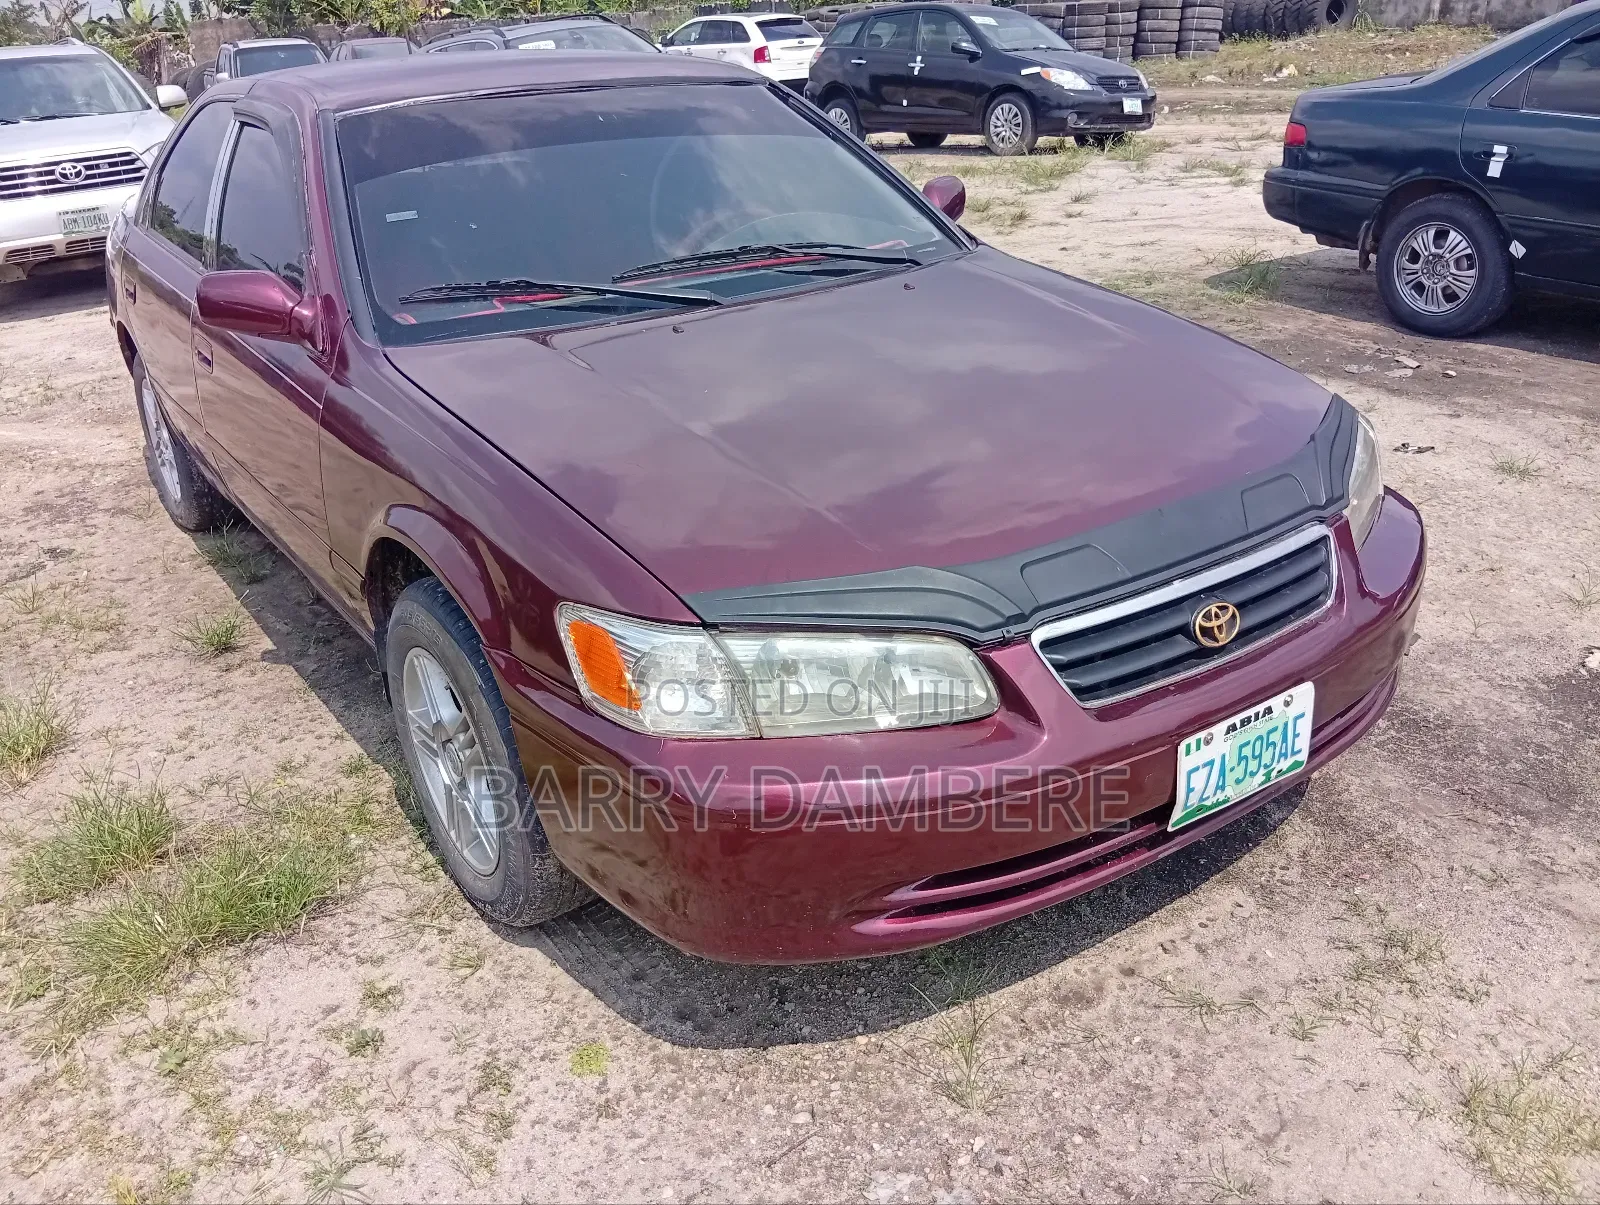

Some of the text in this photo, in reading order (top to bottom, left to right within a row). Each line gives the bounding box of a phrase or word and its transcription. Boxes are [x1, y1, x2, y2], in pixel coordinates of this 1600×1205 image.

[62, 212, 110, 231] ABM-104KU
[1223, 704, 1274, 737] ABIA
[1183, 711, 1306, 810] EZA-595AE
